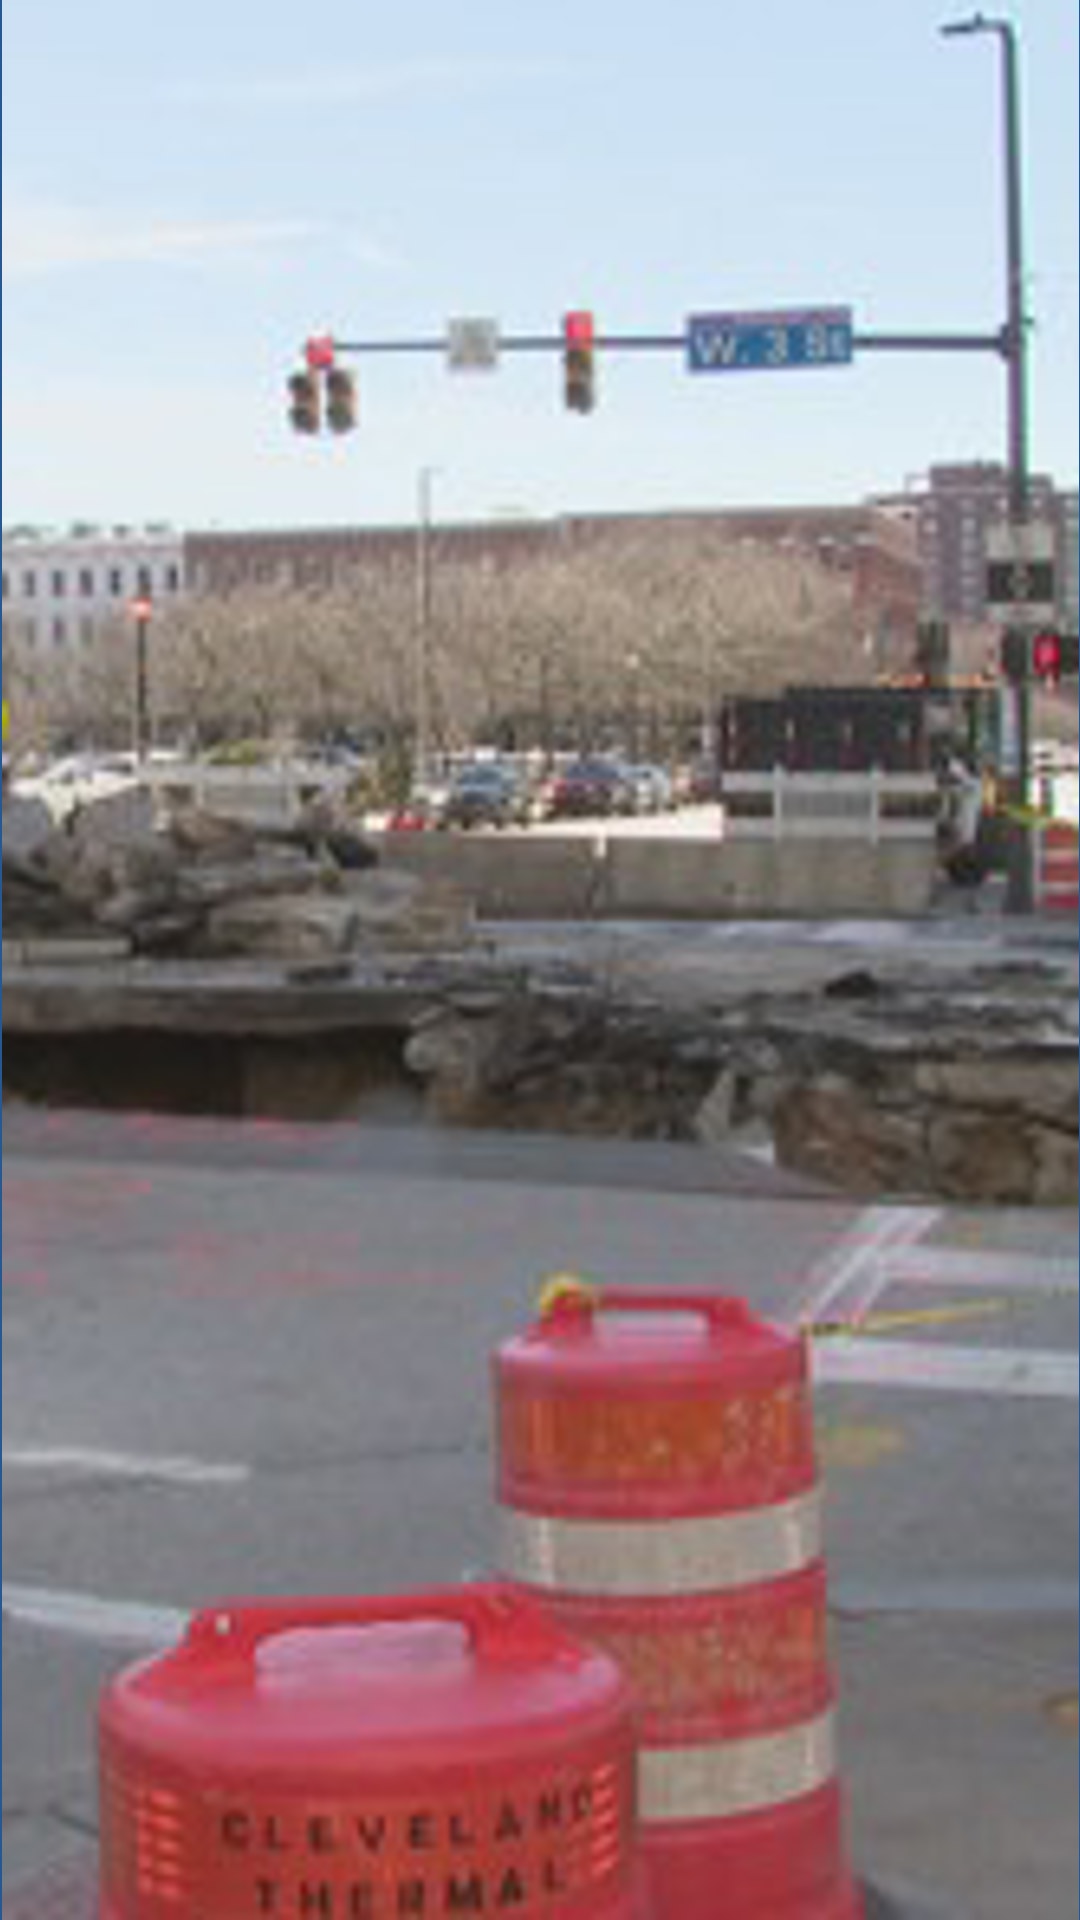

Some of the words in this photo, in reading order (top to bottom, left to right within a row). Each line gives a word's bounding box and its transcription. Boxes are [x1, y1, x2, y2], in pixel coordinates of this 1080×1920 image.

[695, 325, 750, 364] W.
[764, 326, 789, 364] 3
[219, 1782, 595, 1852] CLEVELAND
[255, 1858, 569, 1915] THERMAL
